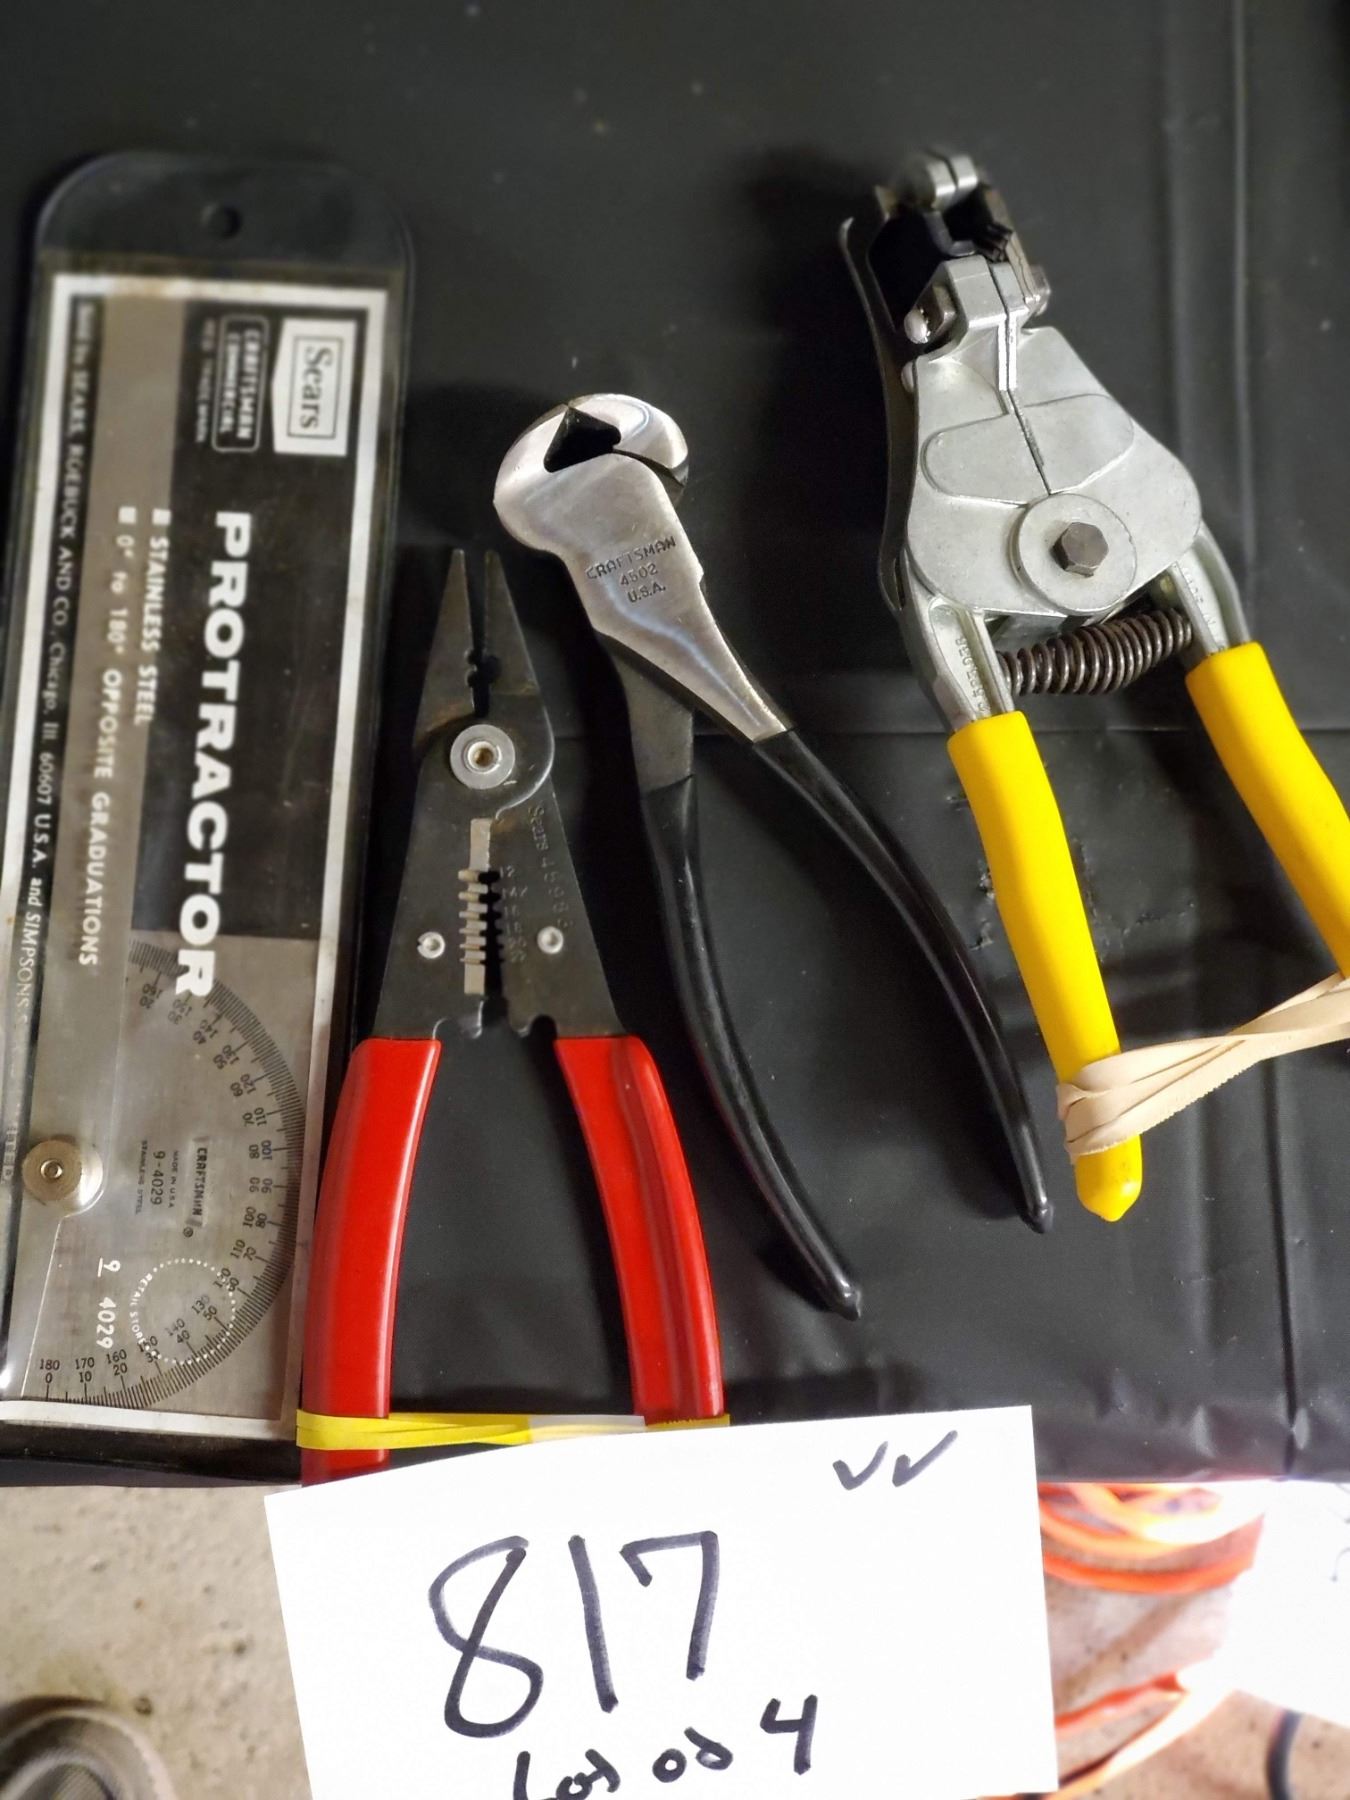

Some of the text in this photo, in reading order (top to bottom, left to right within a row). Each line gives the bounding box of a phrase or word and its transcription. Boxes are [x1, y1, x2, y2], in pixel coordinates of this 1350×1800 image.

[237, 329, 261, 439] CRAFTSMAN
[300, 347, 333, 428] Sears
[58, 444, 84, 539] ROEBUCK
[55, 544, 78, 591] AND
[585, 535, 676, 579] CRAFTSMAN
[110, 571, 128, 594] to
[627, 582, 667, 603] U.S.A.
[134, 536, 169, 726] STAINLESS STEEL
[93, 668, 122, 779] OPPOSITE
[175, 511, 252, 997] PROTRACTOR
[35, 751, 55, 805] 60607
[31, 812, 52, 869] U.S.A.
[27, 877, 43, 906] and
[78, 791, 111, 966] GRADUATIONS
[213, 1054, 228, 1070] 50
[230, 1082, 244, 1097] 60
[240, 1074, 257, 1094] 120
[242, 1112, 255, 1128] 70
[254, 1107, 267, 1127] 110
[249, 1144, 260, 1160] 80
[261, 1140, 273, 1161] 100
[150, 1150, 166, 1206] 9-4029
[192, 1147, 208, 1216] CRAFTSMAN
[255, 1213, 267, 1229] 80
[96, 1259, 121, 1350] 9 4029
[130, 1273, 153, 1306] RETAIL
[40, 1358, 60, 1371] 180
[75, 1357, 95, 1369] 170
[105, 1349, 127, 1364] 160
[113, 1362, 129, 1377] 20
[44, 1373, 54, 1384] 0
[79, 1371, 93, 1384] 10
[427, 1530, 720, 1739] 817
[760, 1694, 818, 1775] 4
